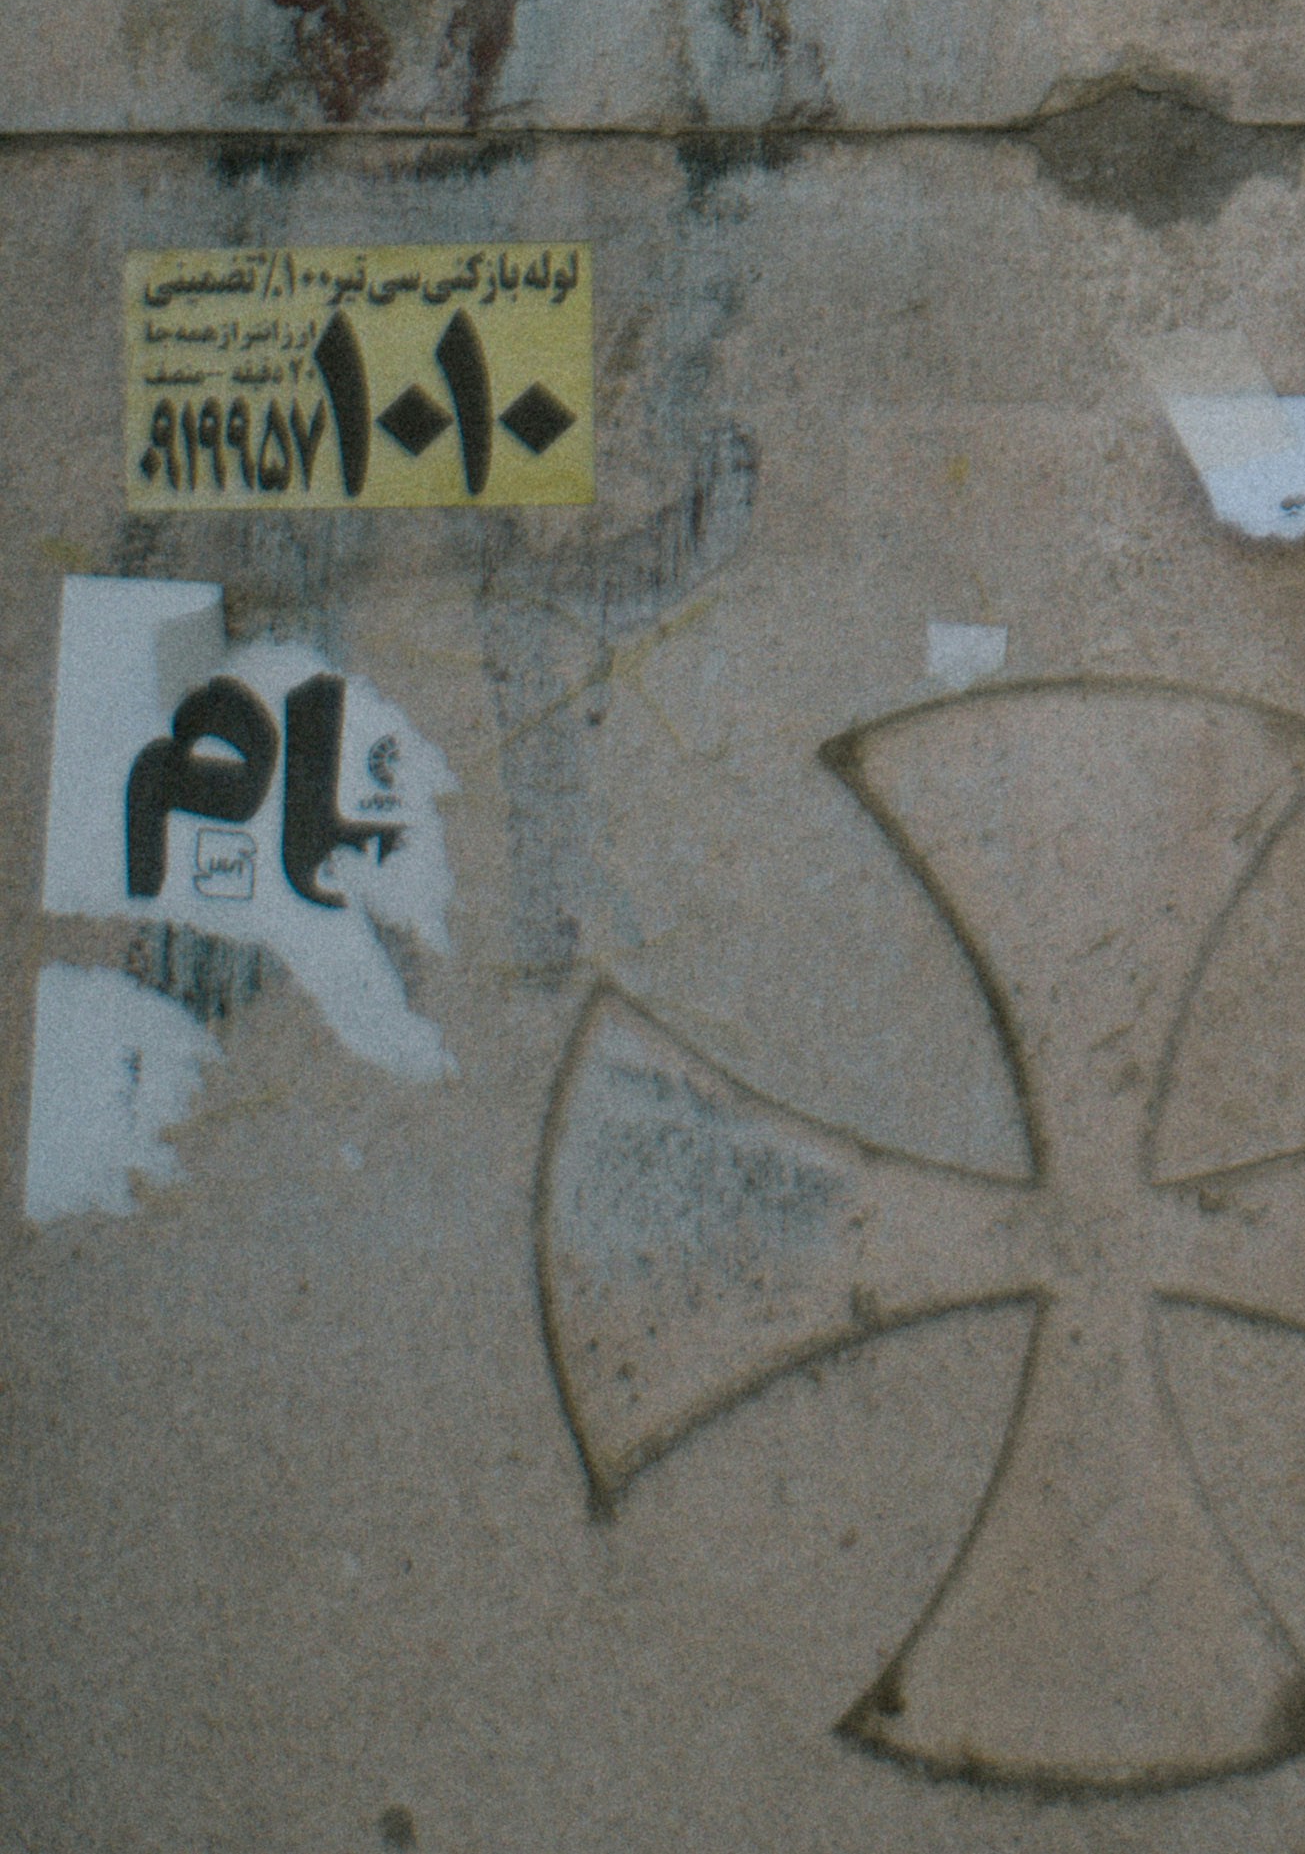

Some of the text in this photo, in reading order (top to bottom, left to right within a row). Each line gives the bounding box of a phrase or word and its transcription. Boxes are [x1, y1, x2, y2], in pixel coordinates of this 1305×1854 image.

[143, 255, 261, 309] تضمینی
[326, 254, 367, 306] تیر
[367, 275, 421, 306] سی
[422, 251, 521, 305] بازکنی
[521, 249, 579, 306] لوله
